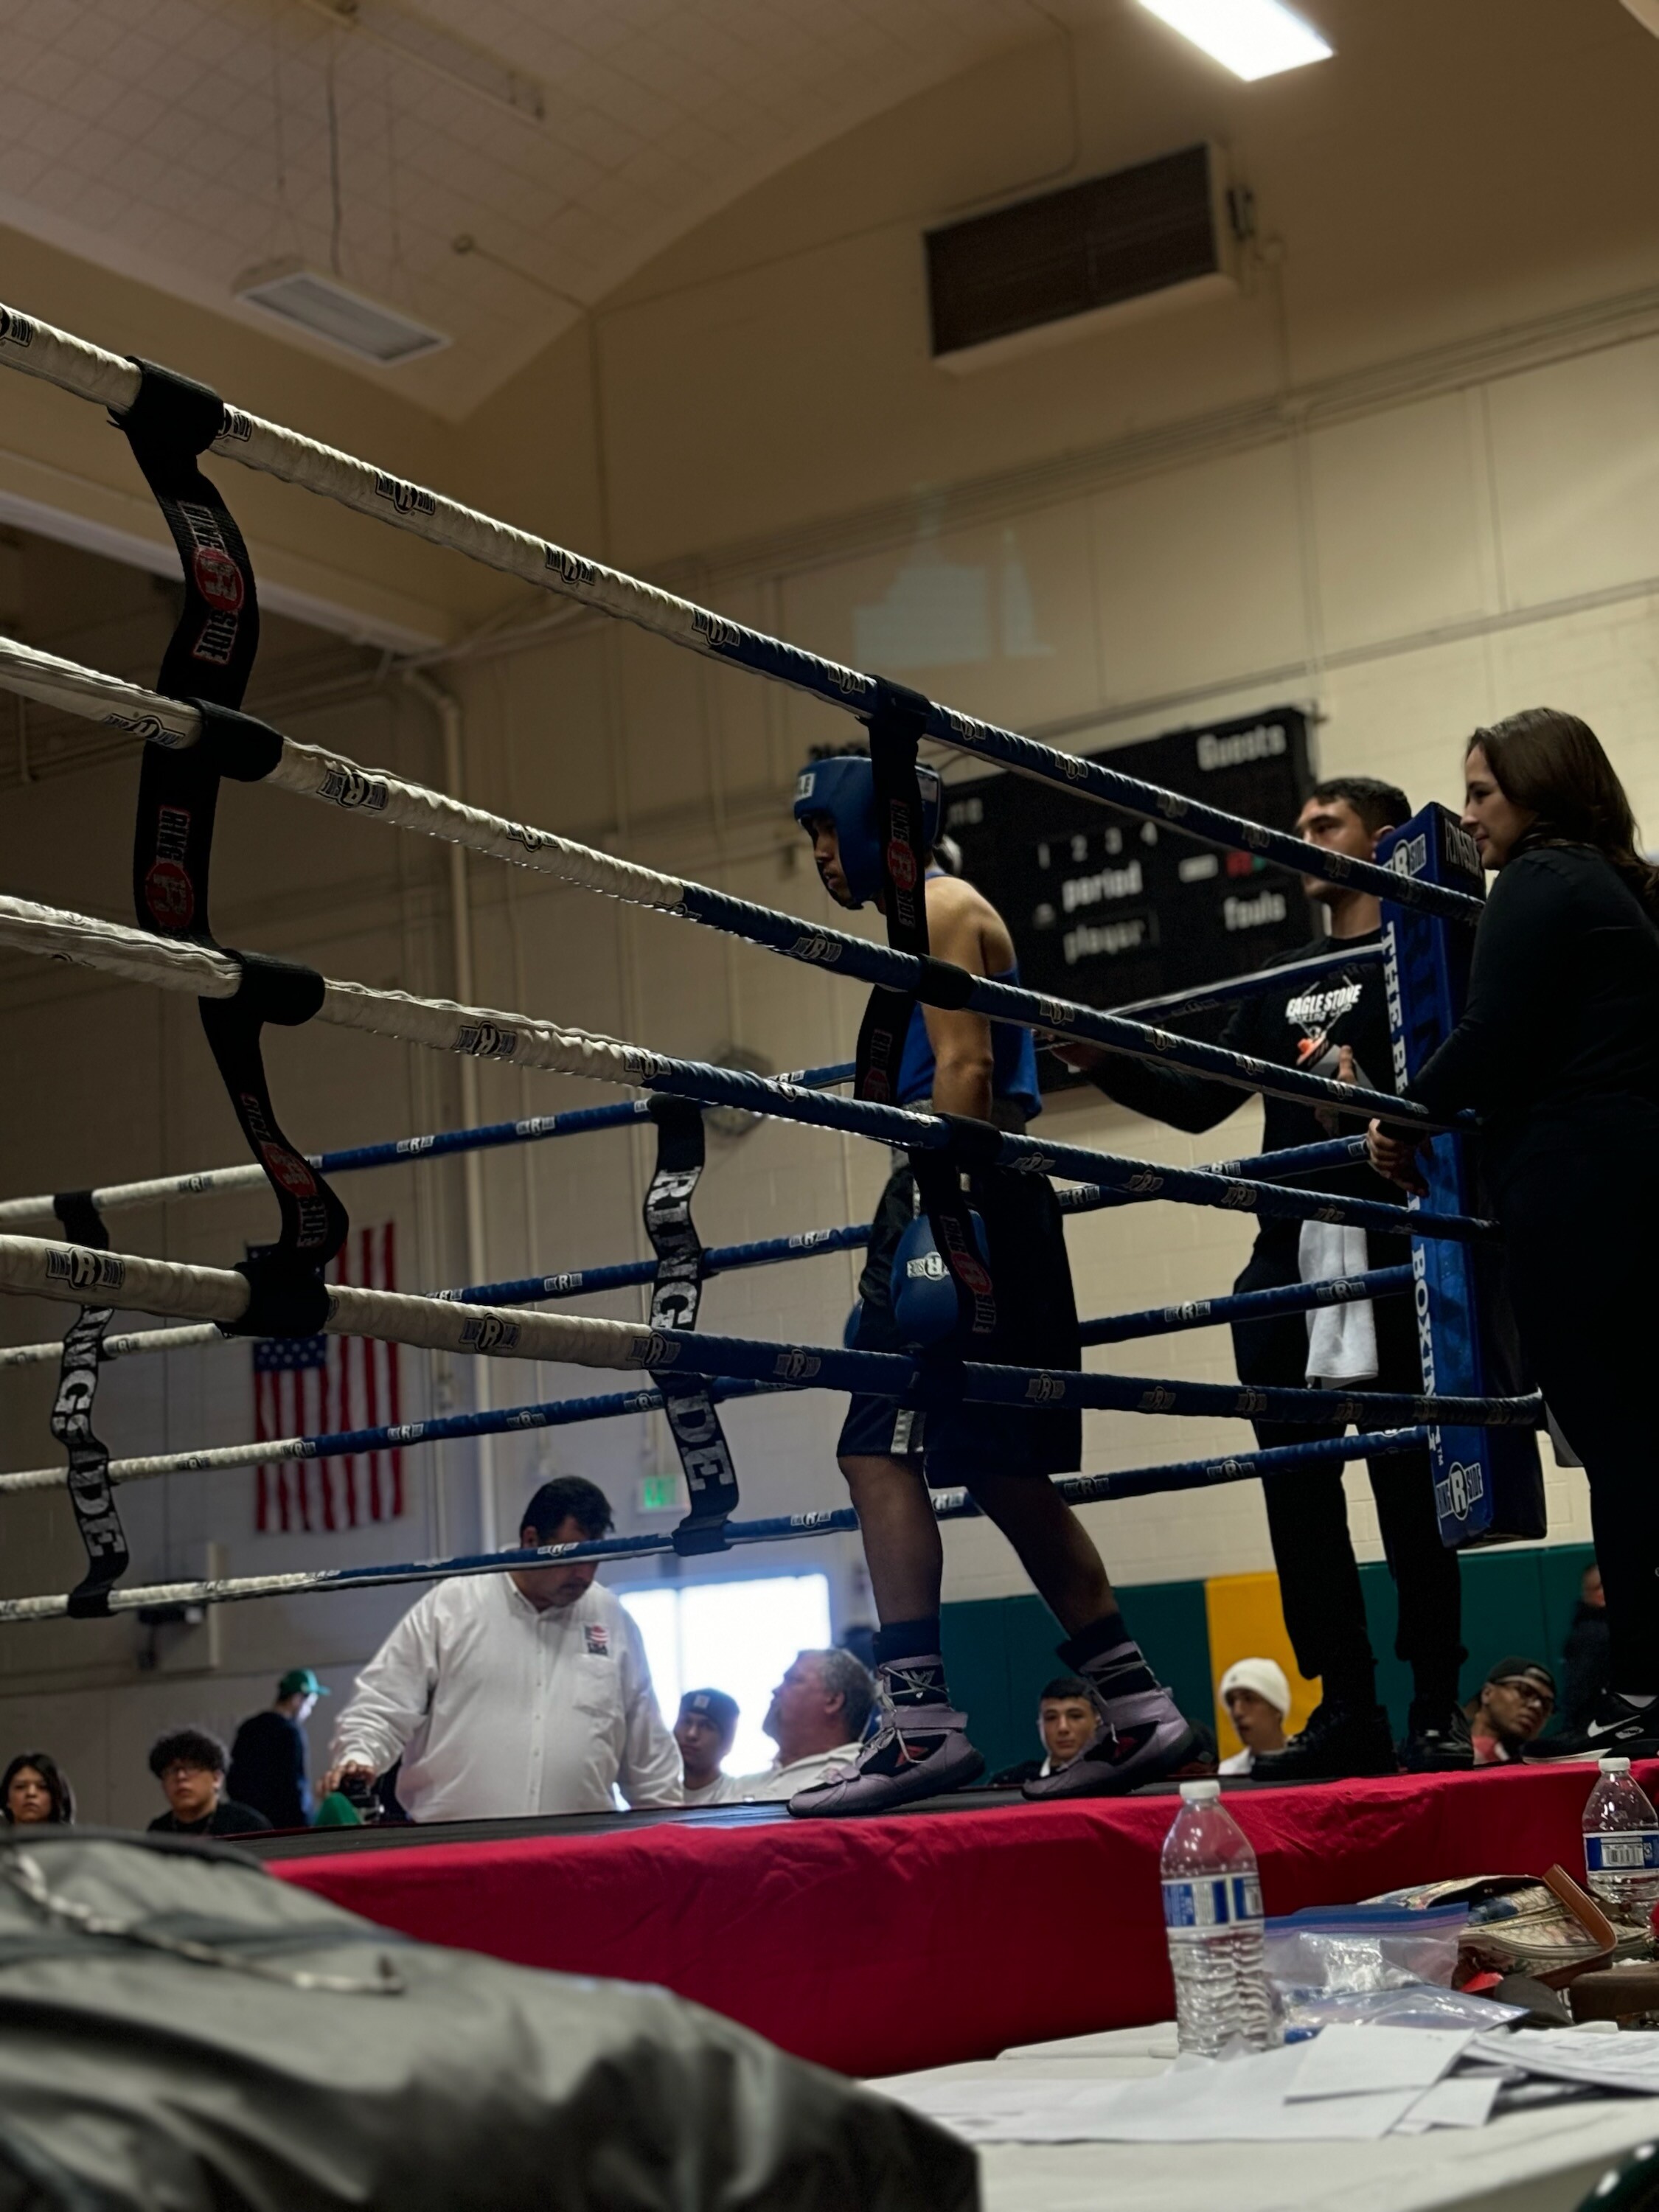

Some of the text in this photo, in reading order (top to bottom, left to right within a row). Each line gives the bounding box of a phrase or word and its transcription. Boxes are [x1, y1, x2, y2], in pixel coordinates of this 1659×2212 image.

[1285, 983, 1363, 1018] EAGLE STONE
[51, 1306, 128, 1558] INGSIDE
[1450, 1469, 1468, 1514] R
